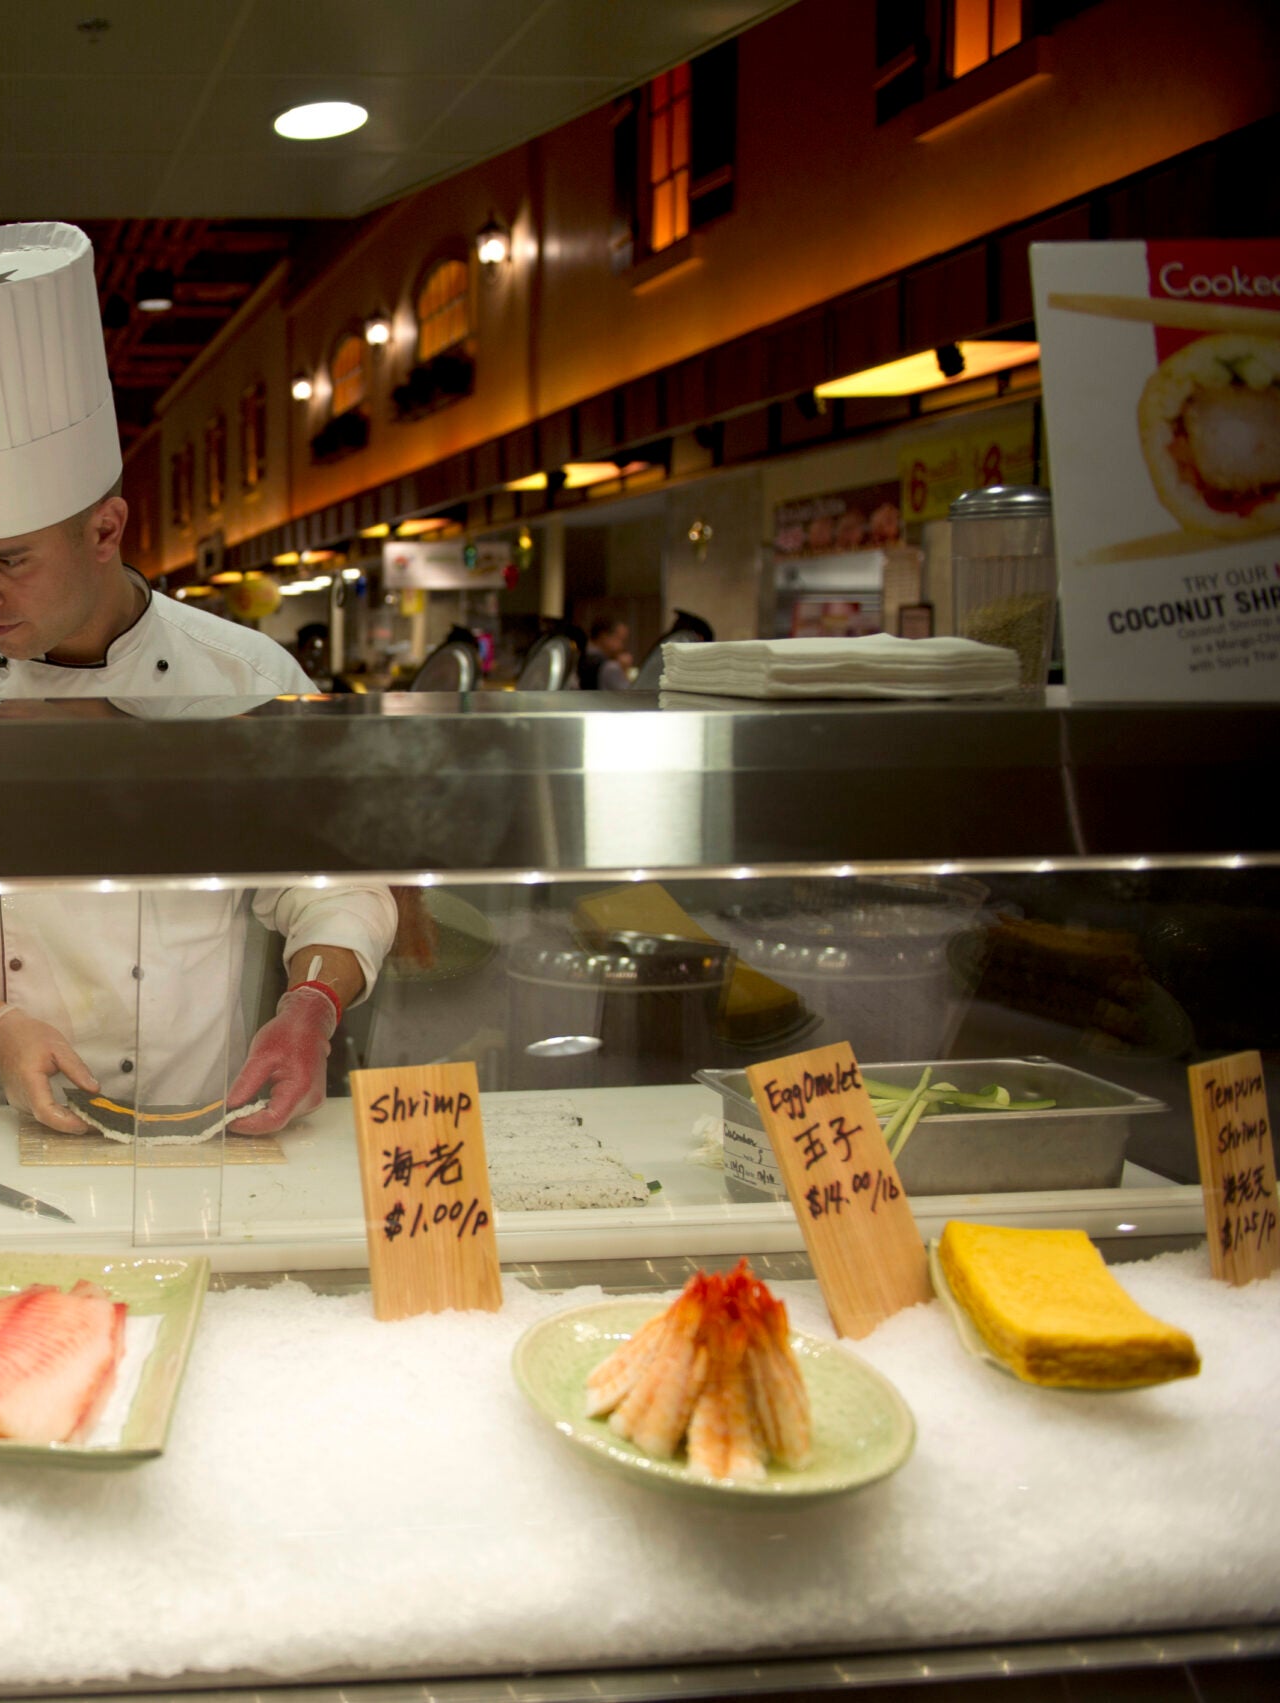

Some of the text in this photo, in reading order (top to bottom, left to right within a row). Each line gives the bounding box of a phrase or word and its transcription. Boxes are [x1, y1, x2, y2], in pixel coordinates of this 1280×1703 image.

[1182, 573, 1219, 594] TRY
[1225, 565, 1268, 587] OUR
[1108, 594, 1224, 634] COCONUT
